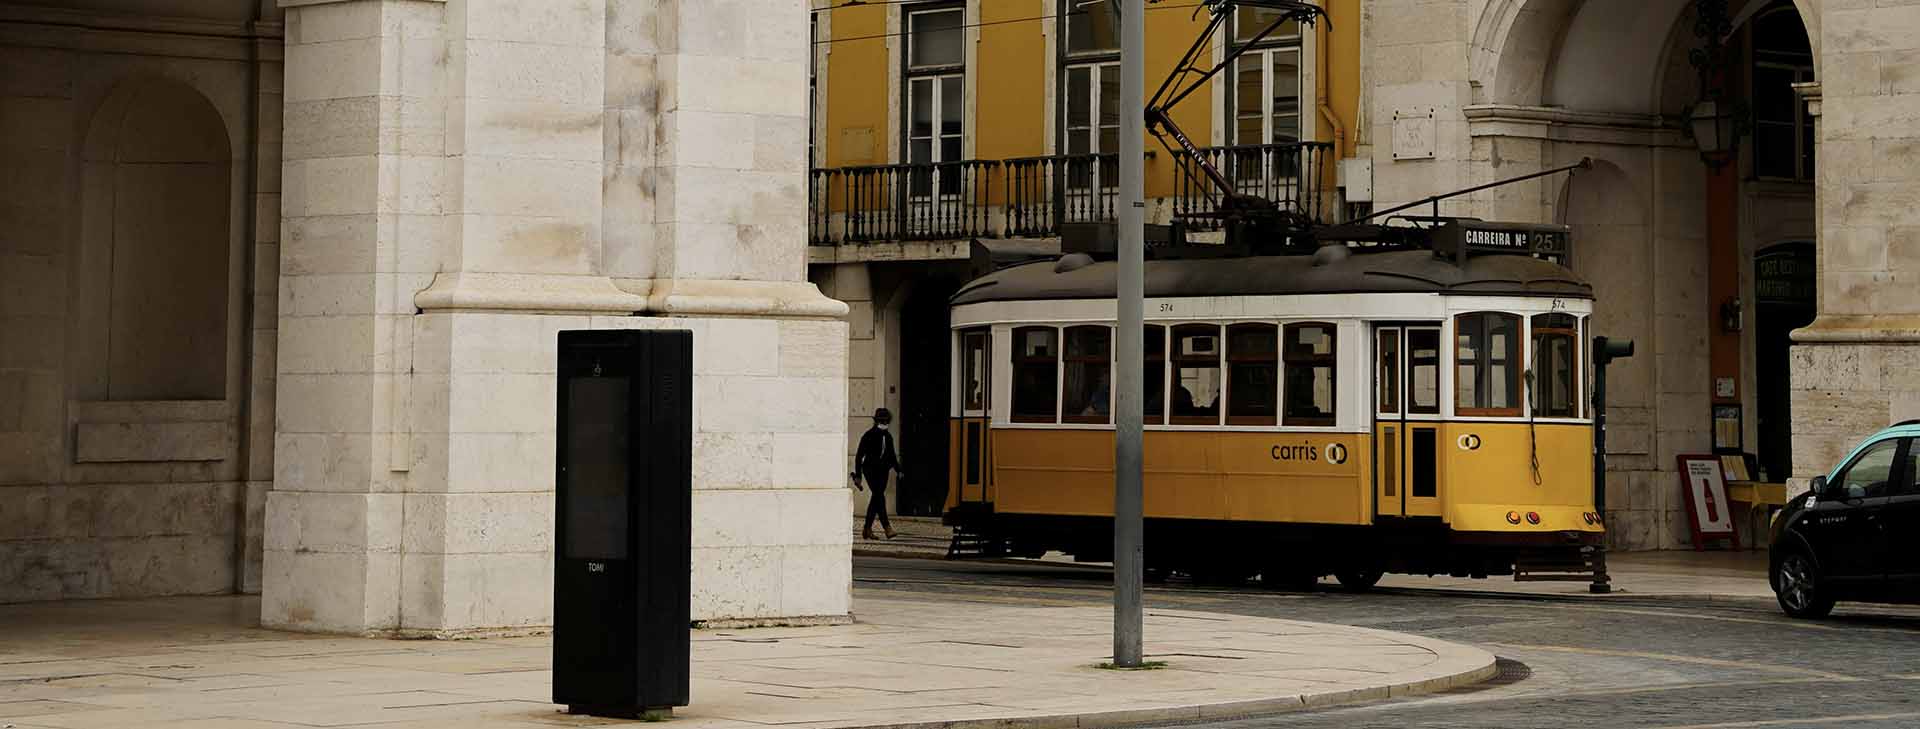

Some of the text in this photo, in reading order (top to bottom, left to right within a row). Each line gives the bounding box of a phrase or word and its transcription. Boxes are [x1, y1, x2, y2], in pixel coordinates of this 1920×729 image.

[1465, 229, 1511, 246] CARREIRA
[1534, 233, 1553, 251] 25
[1159, 303, 1174, 312] 574
[1271, 439, 1318, 461] carris
